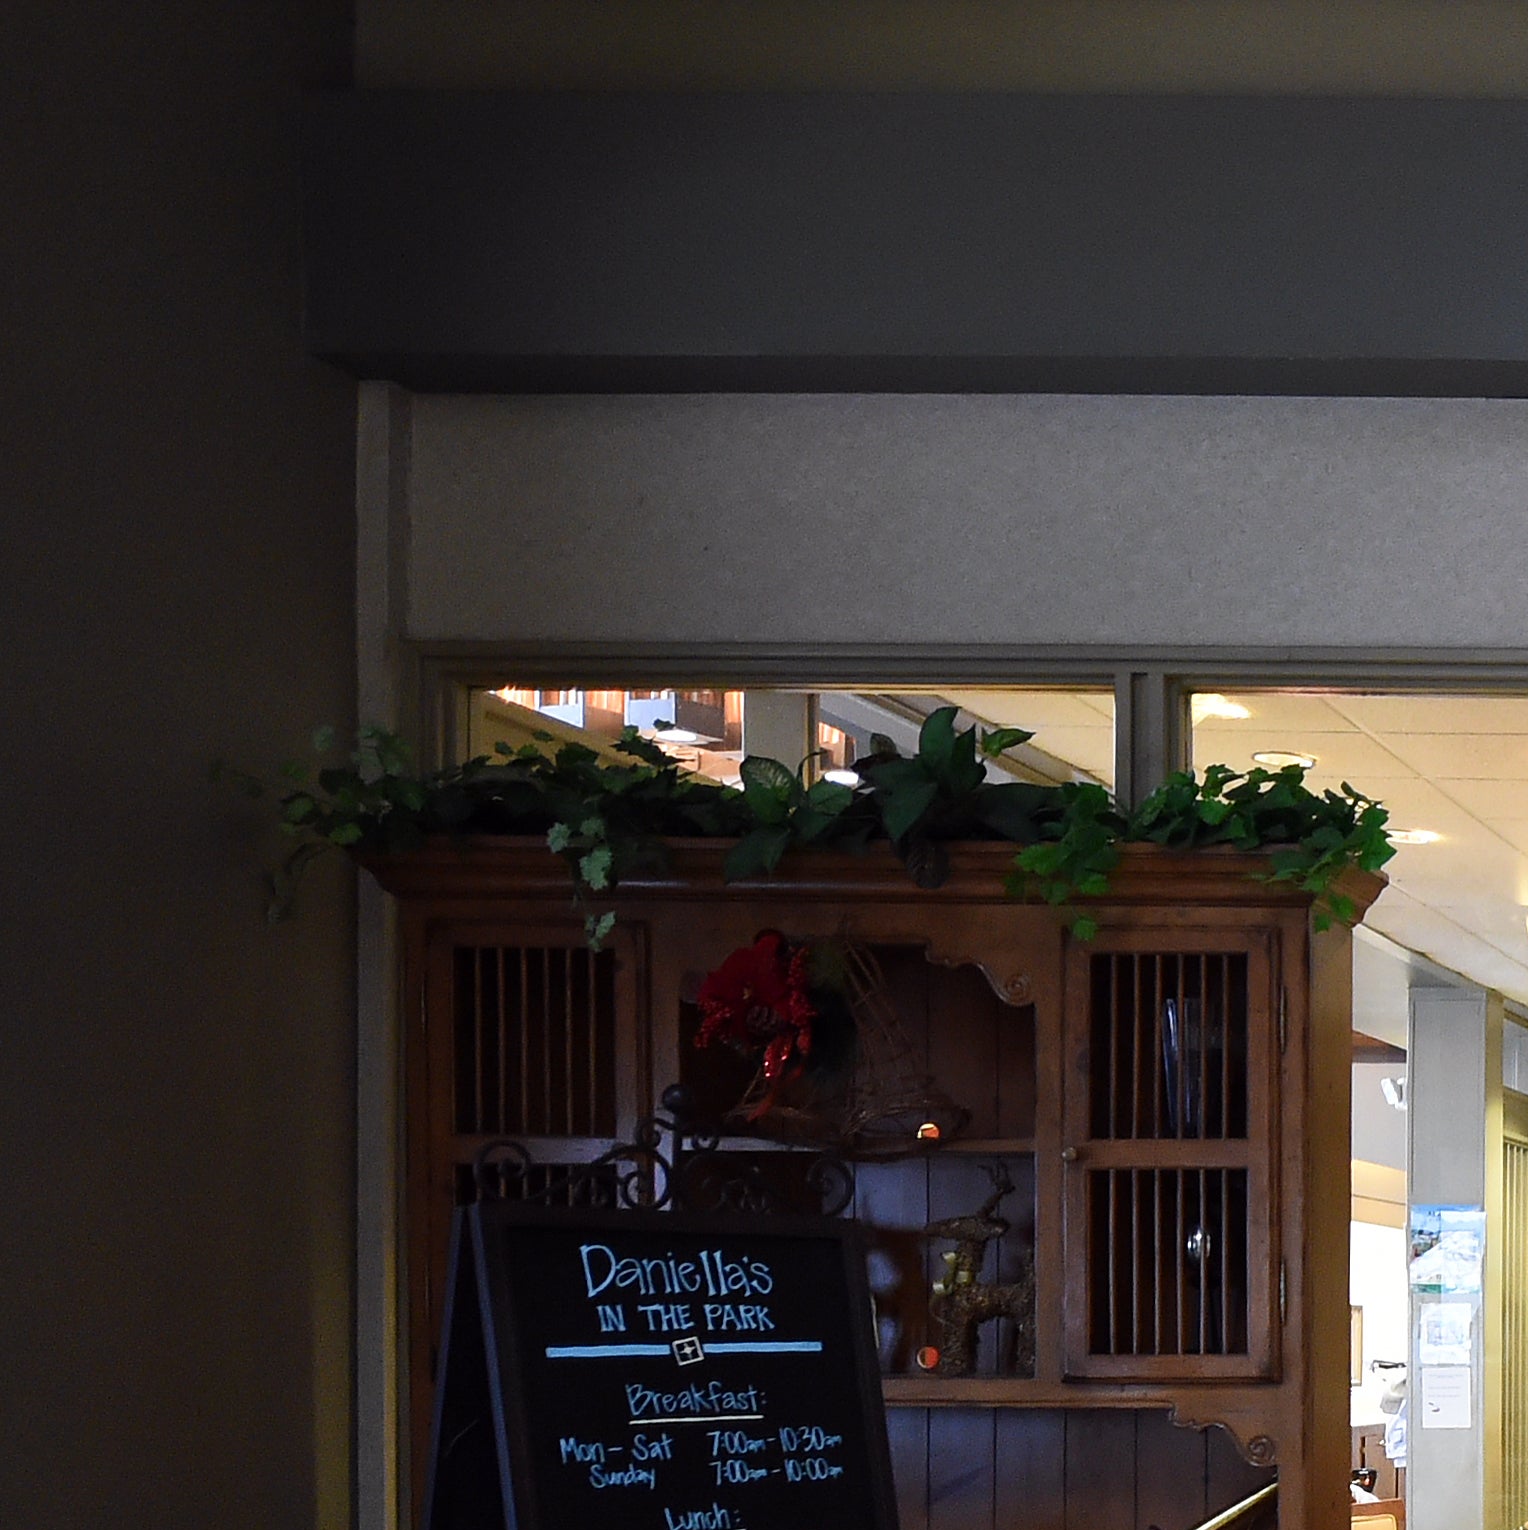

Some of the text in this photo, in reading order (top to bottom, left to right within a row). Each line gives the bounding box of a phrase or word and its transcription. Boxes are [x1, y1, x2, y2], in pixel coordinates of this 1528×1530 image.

[579, 1244, 773, 1298] Daniella's
[596, 1303, 775, 1332] IN THE PARK
[560, 1437, 605, 1464] Mon
[631, 1433, 673, 1460] Sat
[589, 1463, 656, 1490] Sunday
